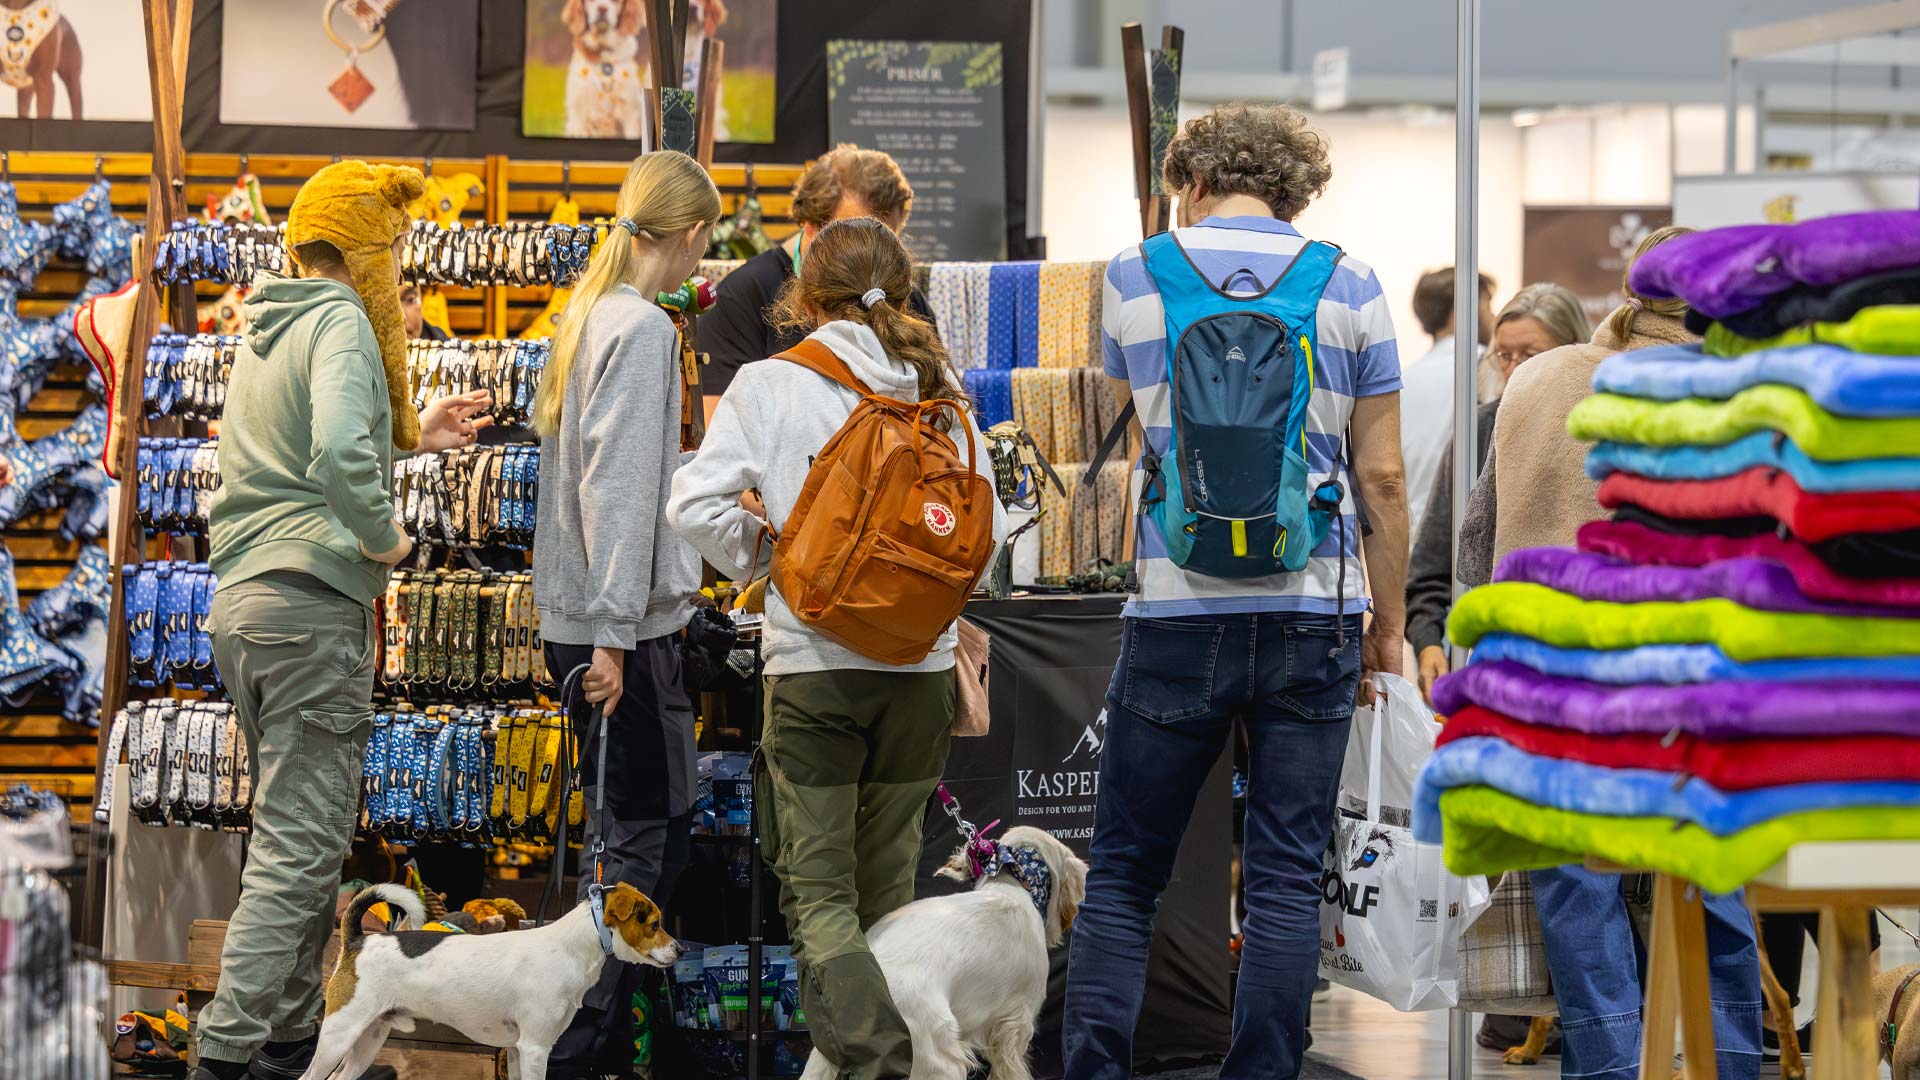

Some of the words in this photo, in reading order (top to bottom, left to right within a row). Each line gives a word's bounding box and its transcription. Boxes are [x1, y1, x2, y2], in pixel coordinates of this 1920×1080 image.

[1018, 806, 1044, 816] DESIGN
[1045, 806, 1060, 815] FOR
[1062, 805, 1077, 814] YOU
[1078, 804, 1092, 813] AND
[1340, 953, 1364, 973] Bite
